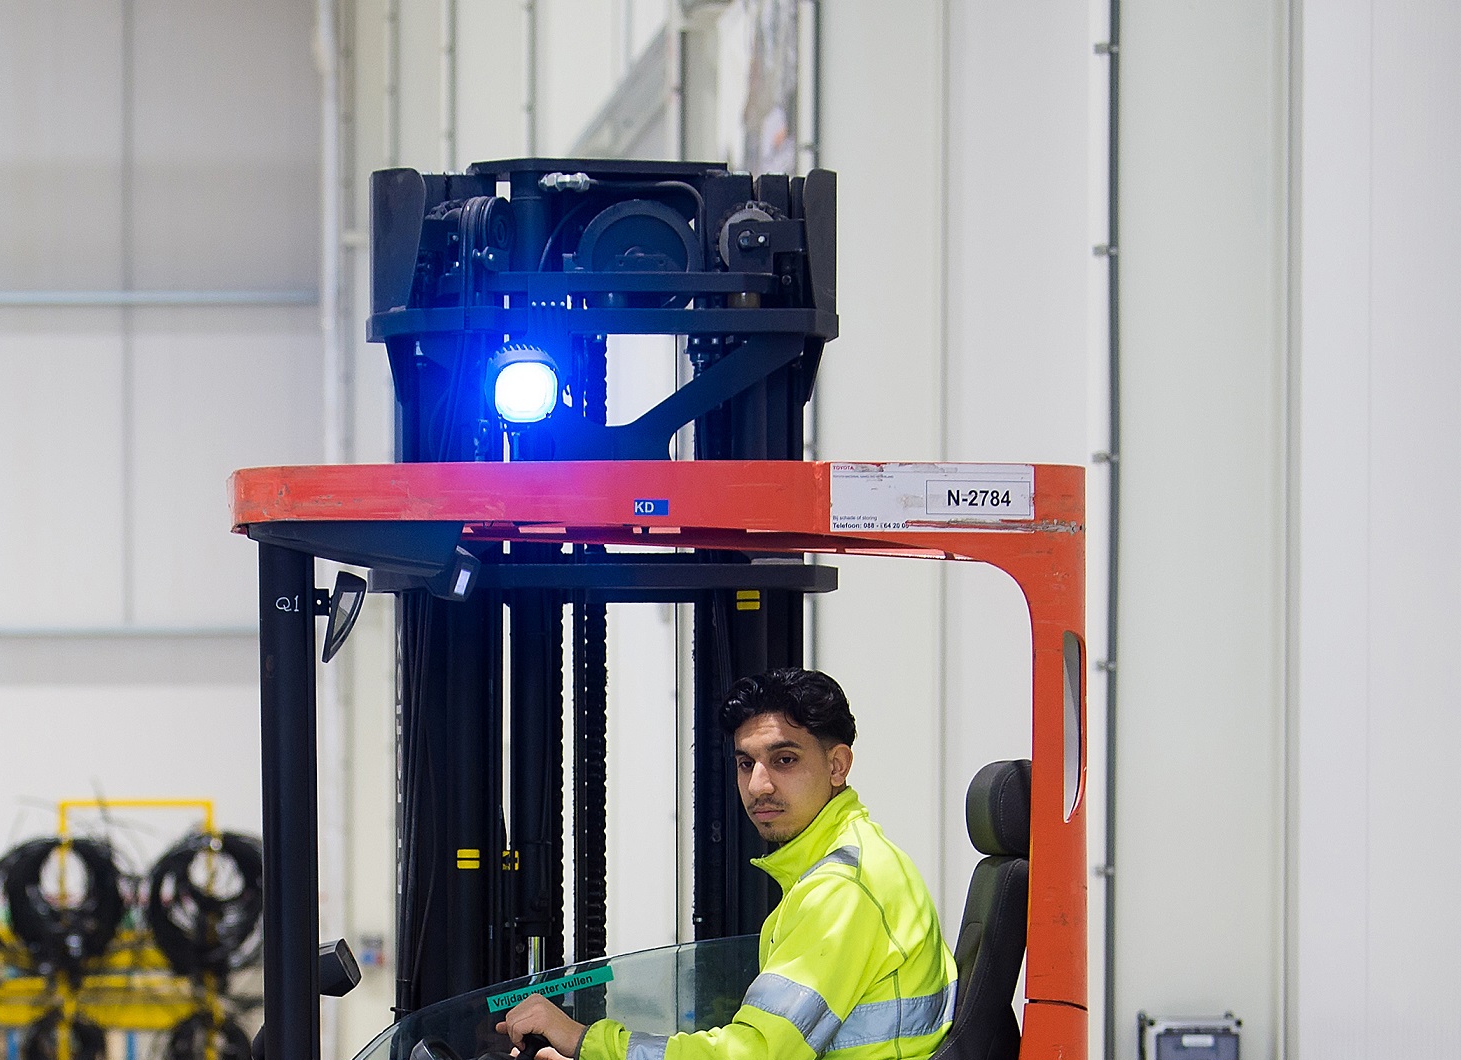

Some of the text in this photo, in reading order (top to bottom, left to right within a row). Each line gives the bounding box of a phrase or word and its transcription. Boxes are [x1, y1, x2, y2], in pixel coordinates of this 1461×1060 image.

[947, 489, 1012, 507] N-2784
[634, 501, 655, 513] KD
[275, 594, 300, 612] Q1
[561, 975, 593, 990] vullen
